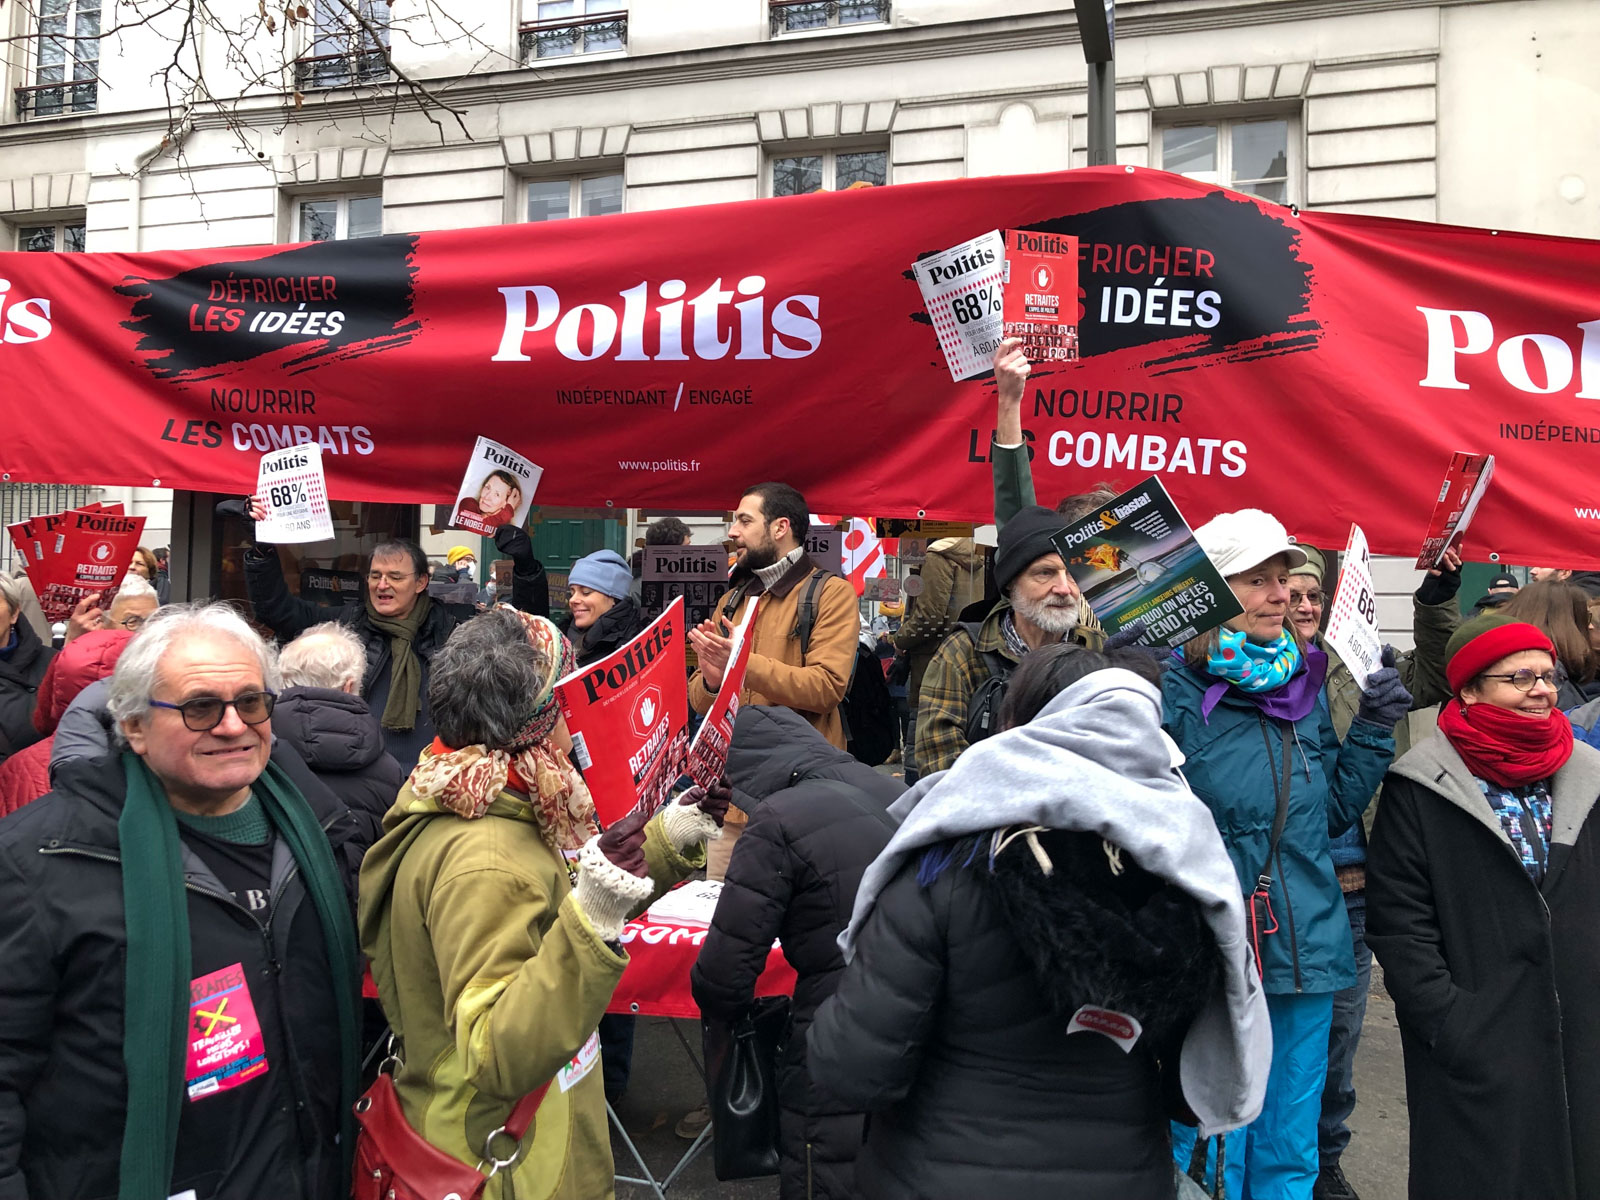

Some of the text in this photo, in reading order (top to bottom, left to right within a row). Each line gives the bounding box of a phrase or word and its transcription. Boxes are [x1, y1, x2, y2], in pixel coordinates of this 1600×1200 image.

[1017, 233, 1069, 255] Politis
[928, 249, 995, 286] Politis
[208, 272, 337, 304] DÉFRICHER
[1025, 293, 1060, 307] RETRAITES
[1100, 277, 1222, 328] IDÉES
[189, 302, 346, 336] LES IDÉES
[491, 275, 823, 362] Politis
[952, 286, 1001, 325] 68%
[979, 341, 992, 354] 60
[992, 337, 1002, 351] AN
[211, 388, 316, 414] NOURRIR
[556, 386, 667, 405] INDÉPENDANT
[689, 385, 753, 405] ENGAGÉ
[1034, 389, 1184, 424] NOURRIR
[161, 418, 375, 455] LES COMBATS
[262, 454, 308, 475] Politis
[483, 446, 531, 479] Politis
[618, 458, 701, 473] www.politis.fr
[968, 429, 1248, 478] LS COMBATS
[270, 482, 307, 508] 68%
[76, 514, 137, 533] Politis
[456, 516, 493, 534] LE NOBEL DU
[76, 564, 118, 575] RETRAITES
[655, 557, 717, 573] Politis
[1162, 598, 1178, 613] ON
[1175, 590, 1192, 606] NE
[1189, 581, 1209, 598] LES
[1132, 613, 1181, 646] NTEND
[1178, 598, 1209, 623] PAS
[581, 619, 673, 706] Politis
[628, 711, 669, 776] RETRAITES
